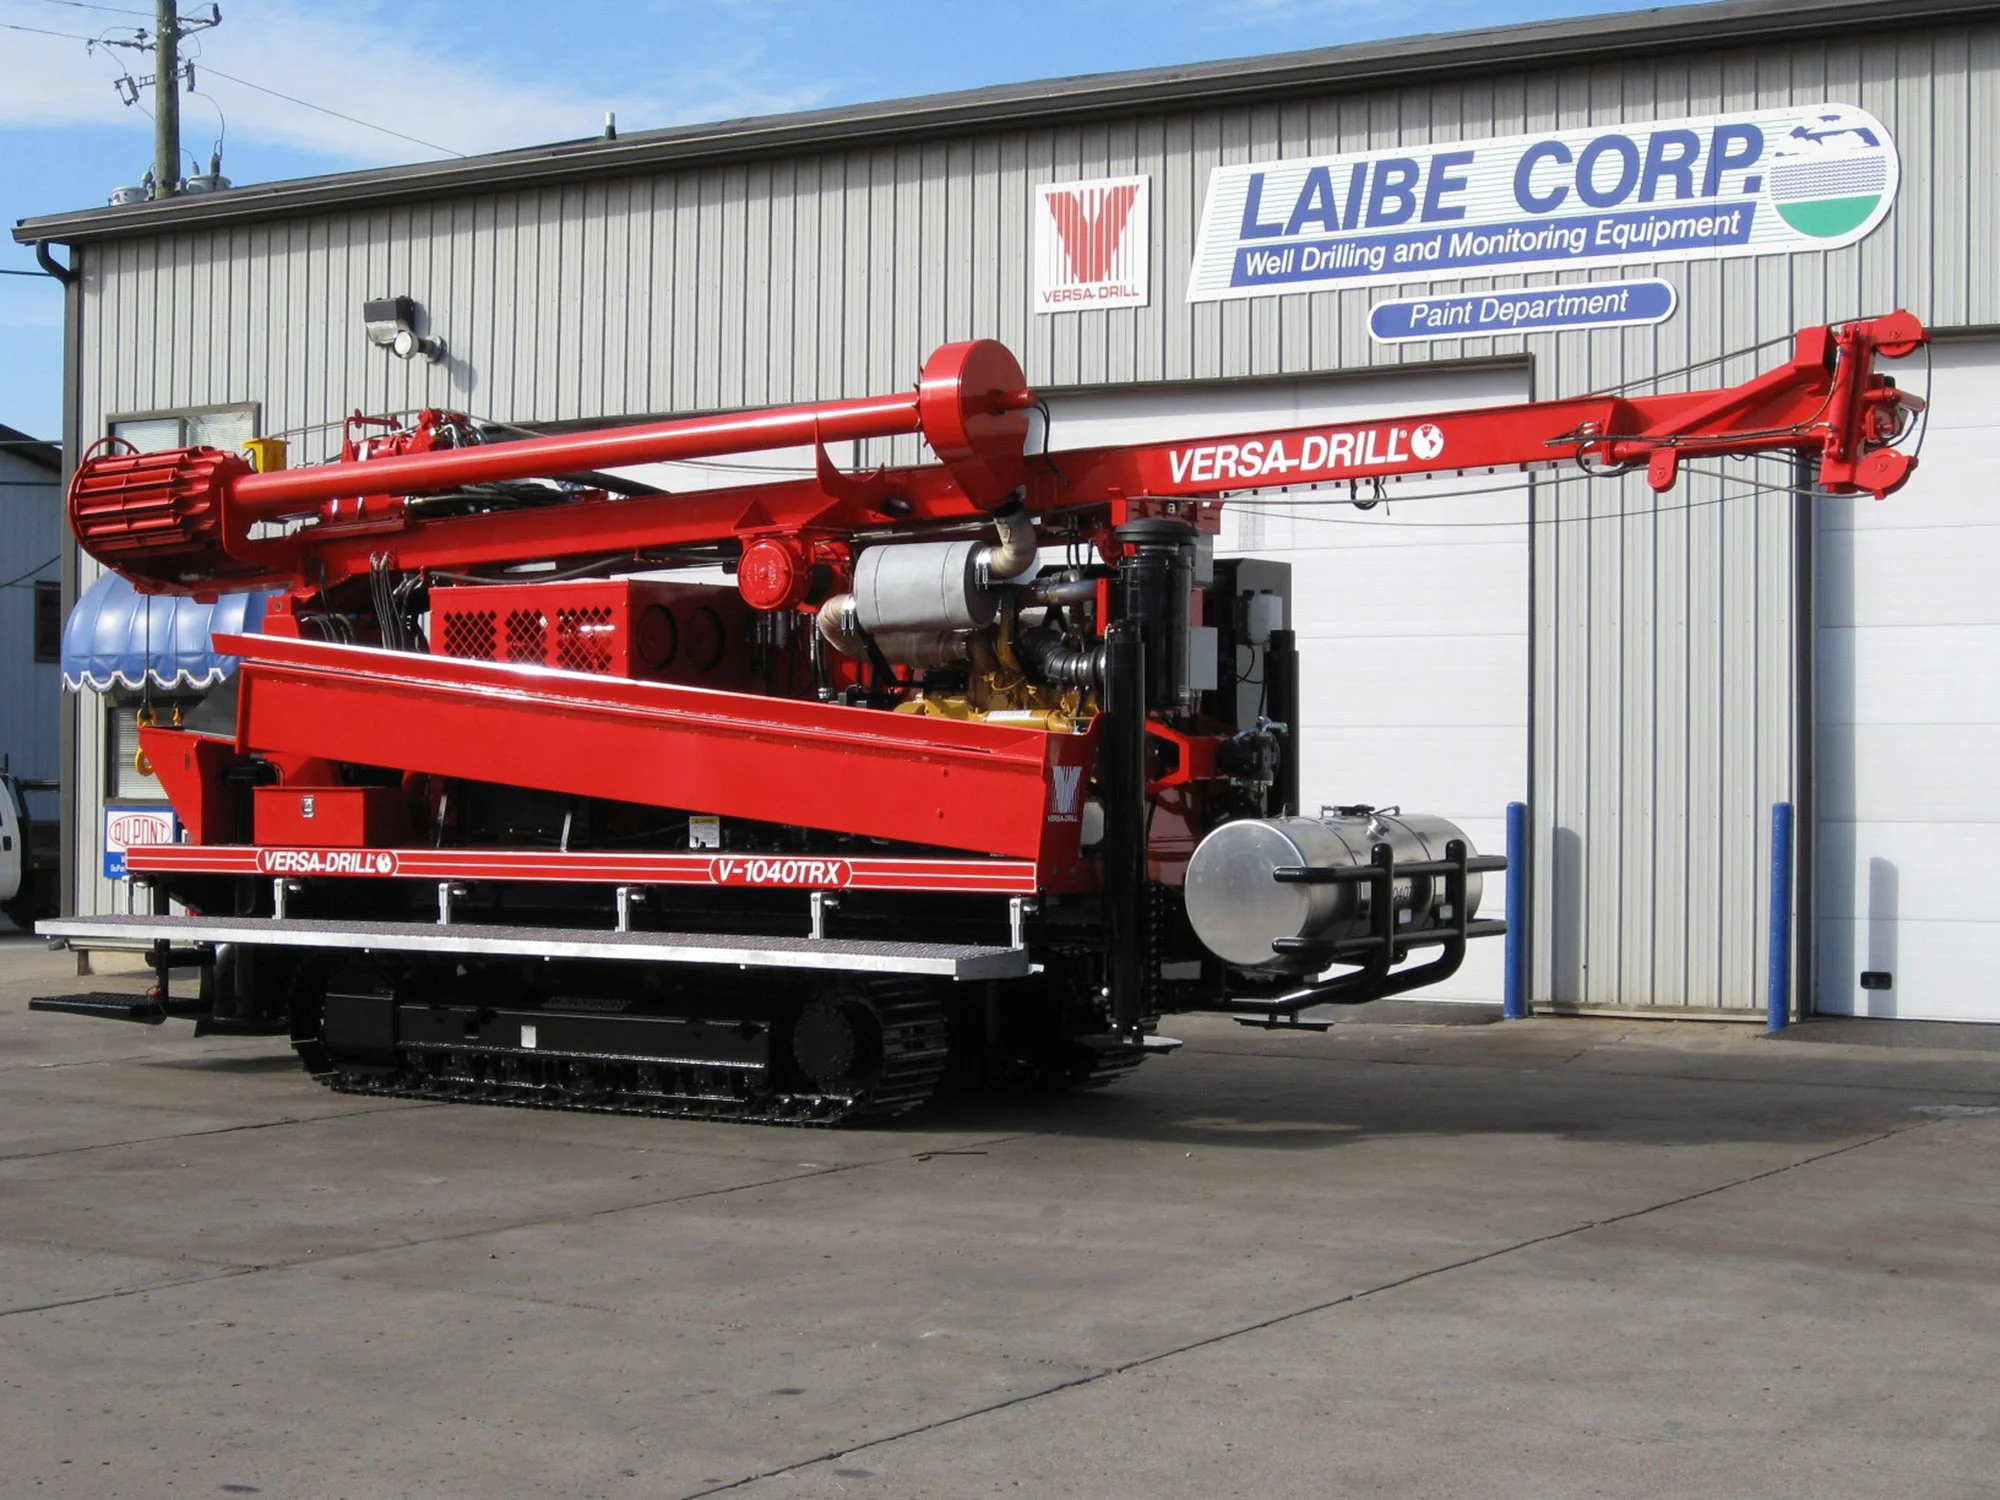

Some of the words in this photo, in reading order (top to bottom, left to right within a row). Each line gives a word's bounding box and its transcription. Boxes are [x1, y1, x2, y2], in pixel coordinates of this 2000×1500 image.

[1240, 151, 1475, 240] LAIBE
[1513, 124, 1764, 214] CORP.
[1246, 249, 1295, 276] Well
[1300, 245, 1386, 272] Drilling
[1393, 235, 1442, 263] and
[1448, 220, 1587, 258] Monitoring
[1595, 210, 1741, 250] Equipment
[1410, 302, 1472, 328] Paint
[1479, 289, 1630, 326] Department
[718, 860, 841, 884] V-1040TRX
